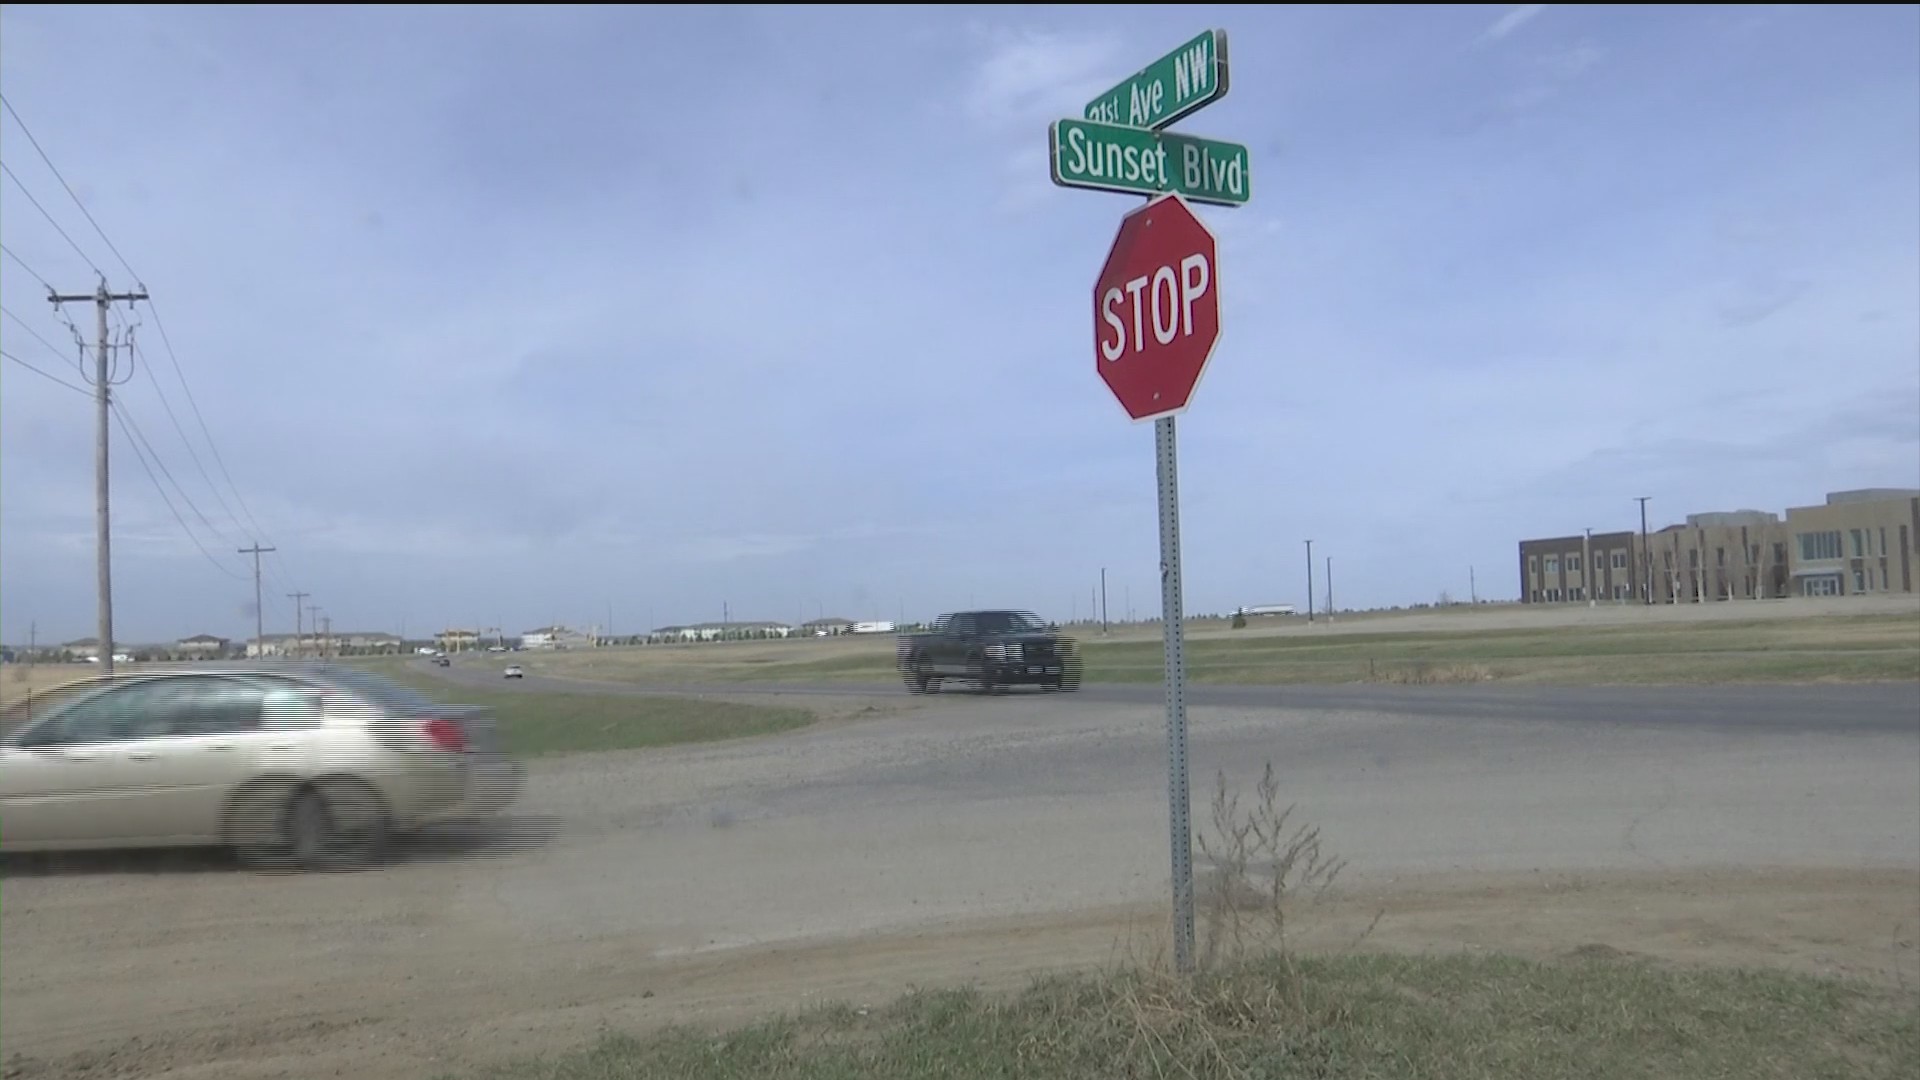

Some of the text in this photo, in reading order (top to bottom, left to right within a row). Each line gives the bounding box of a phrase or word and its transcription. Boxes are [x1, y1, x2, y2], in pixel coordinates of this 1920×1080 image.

[1130, 79, 1163, 126] Ave
[1174, 40, 1208, 102] NW
[1068, 127, 1242, 194] Sunset Blvd
[1101, 253, 1210, 362] STOP
